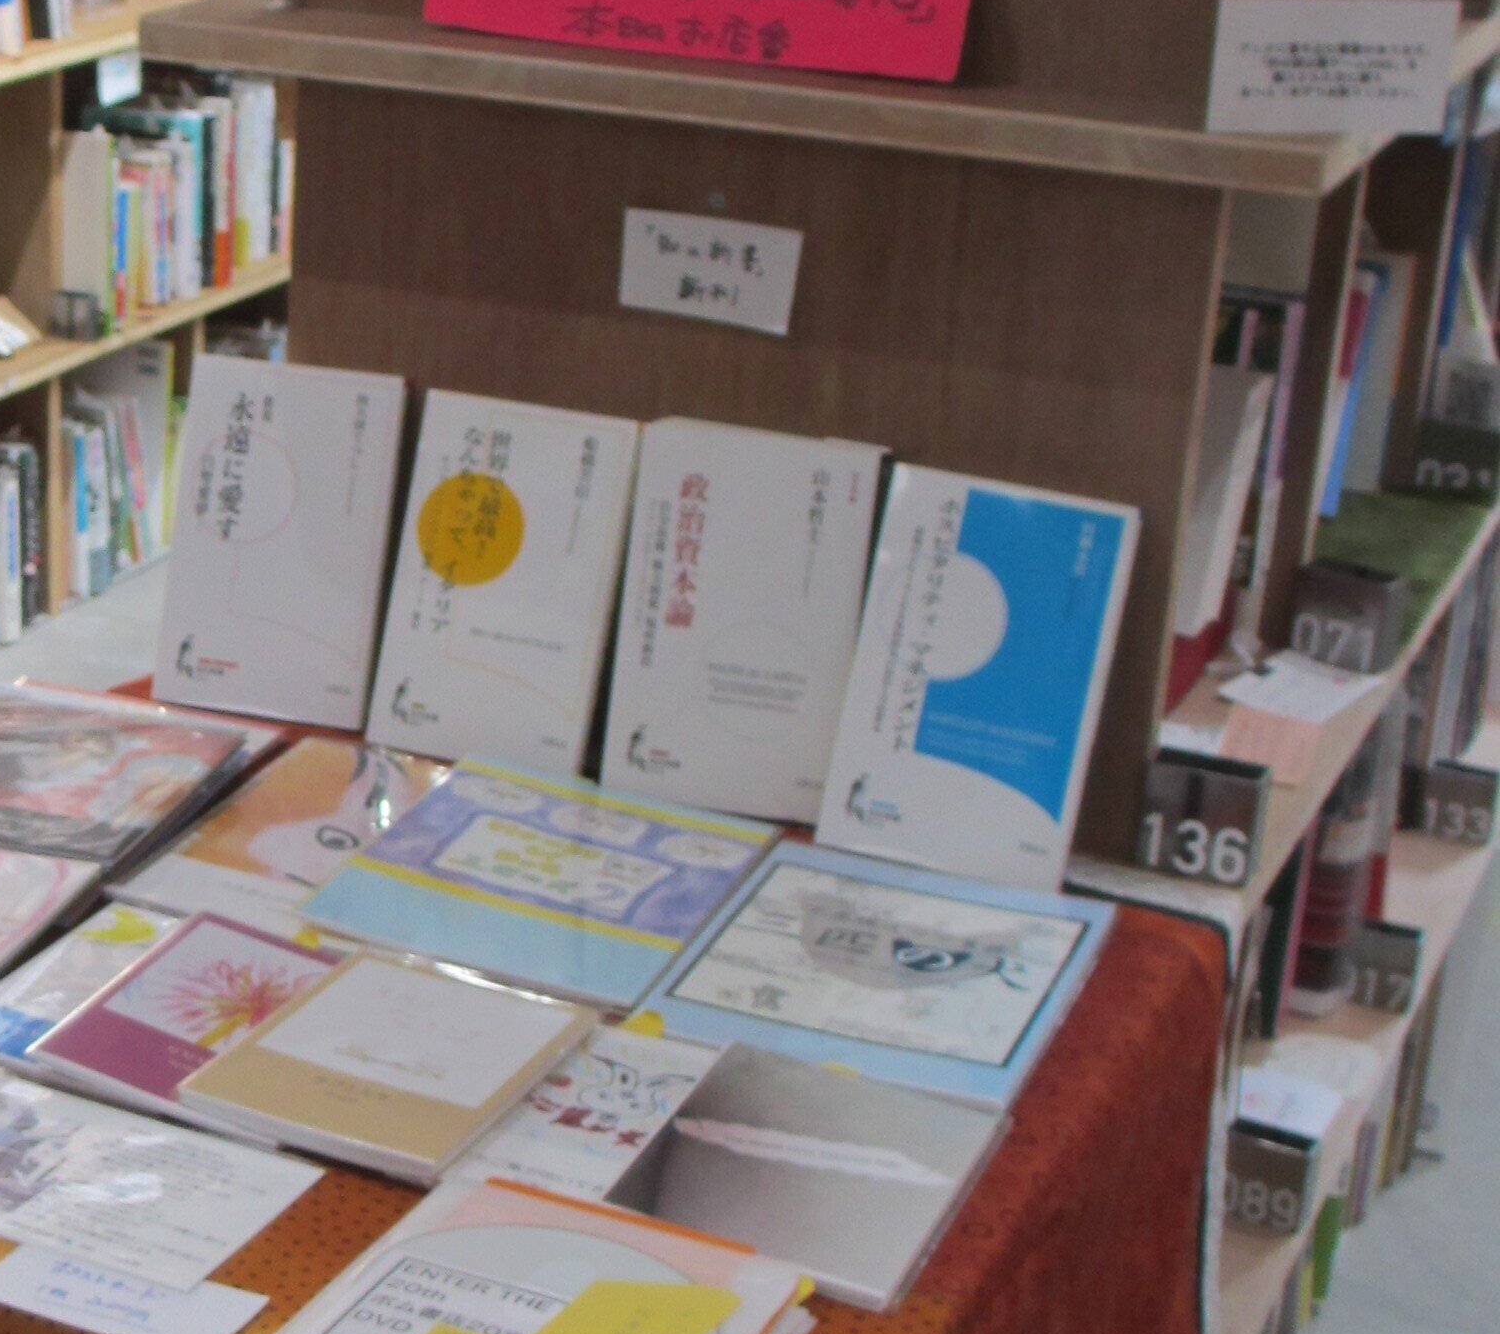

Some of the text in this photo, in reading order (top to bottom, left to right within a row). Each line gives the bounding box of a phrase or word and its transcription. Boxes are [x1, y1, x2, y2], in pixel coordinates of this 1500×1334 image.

[1141, 811, 1251, 884] 136
[401, 1262, 556, 1313] ENTER THE
[353, 1309, 414, 1334] DVD
